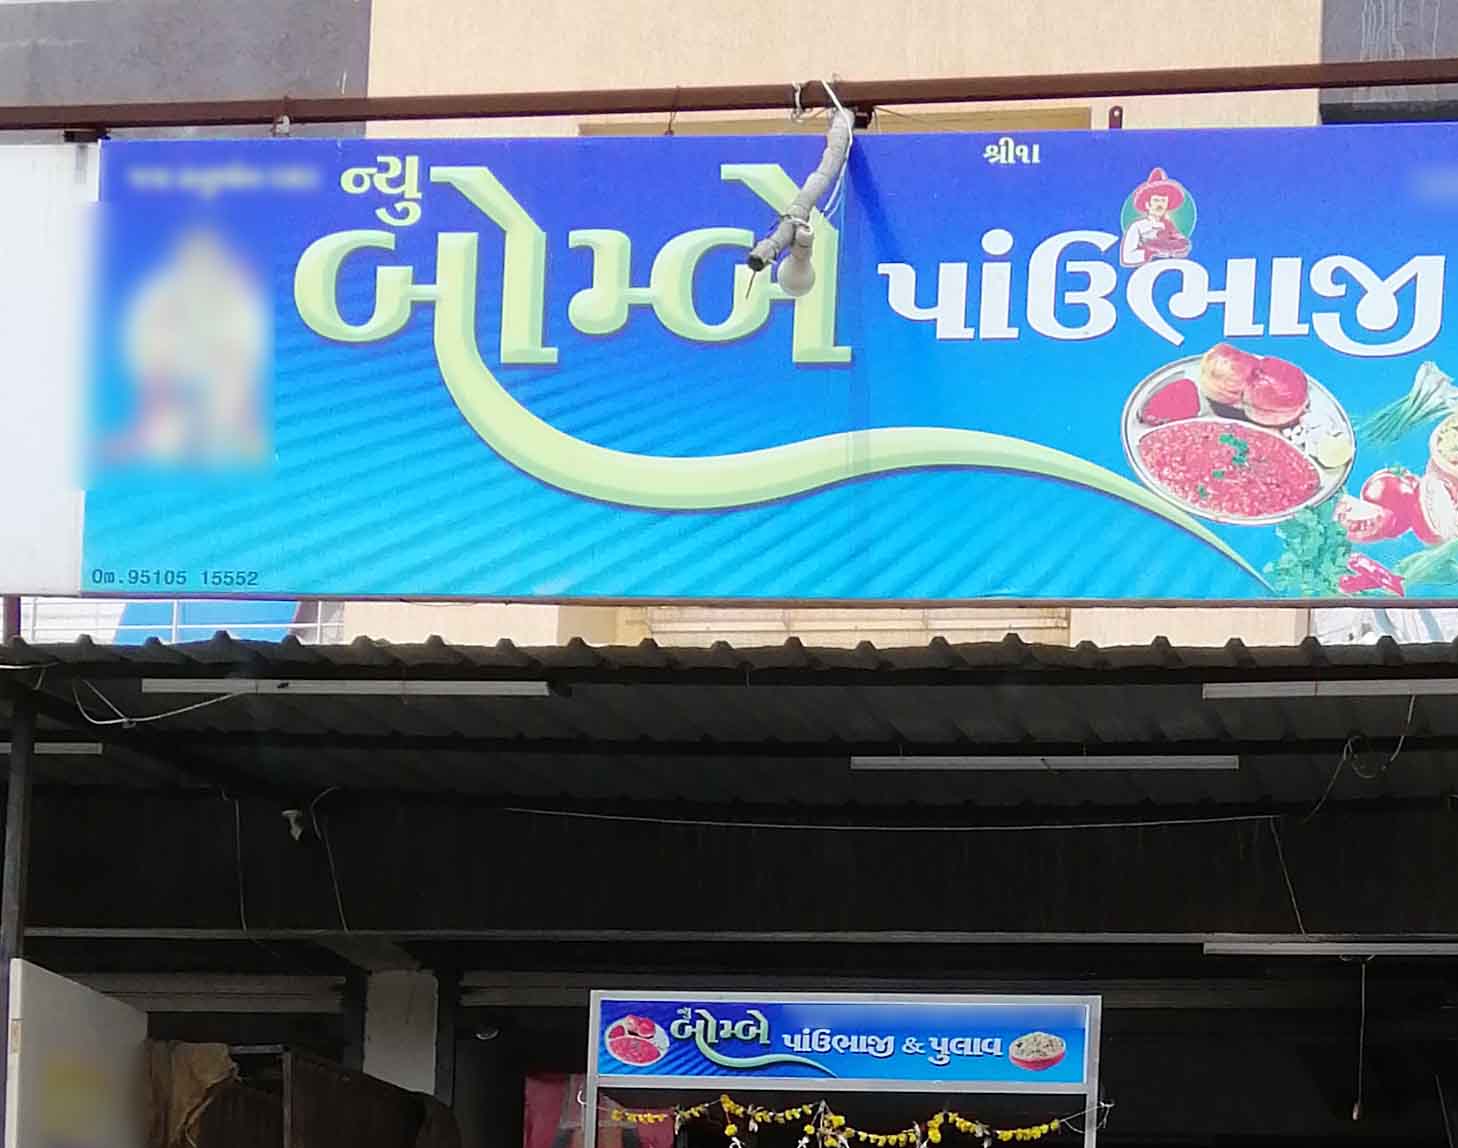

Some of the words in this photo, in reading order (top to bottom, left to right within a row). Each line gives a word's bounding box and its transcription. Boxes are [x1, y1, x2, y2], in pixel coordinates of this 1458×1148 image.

[340, 154, 423, 226] ન્યુ
[293, 163, 853, 365] બોમ્બે
[877, 228, 1446, 357] પાંઉભાજી
[201, 571, 259, 587] 15552
[670, 1009, 771, 1044] બોમ્બે
[782, 1028, 896, 1058] પાંઉભાજી
[901, 1036, 926, 1054] &
[927, 1036, 1004, 1066] પુલાવ
